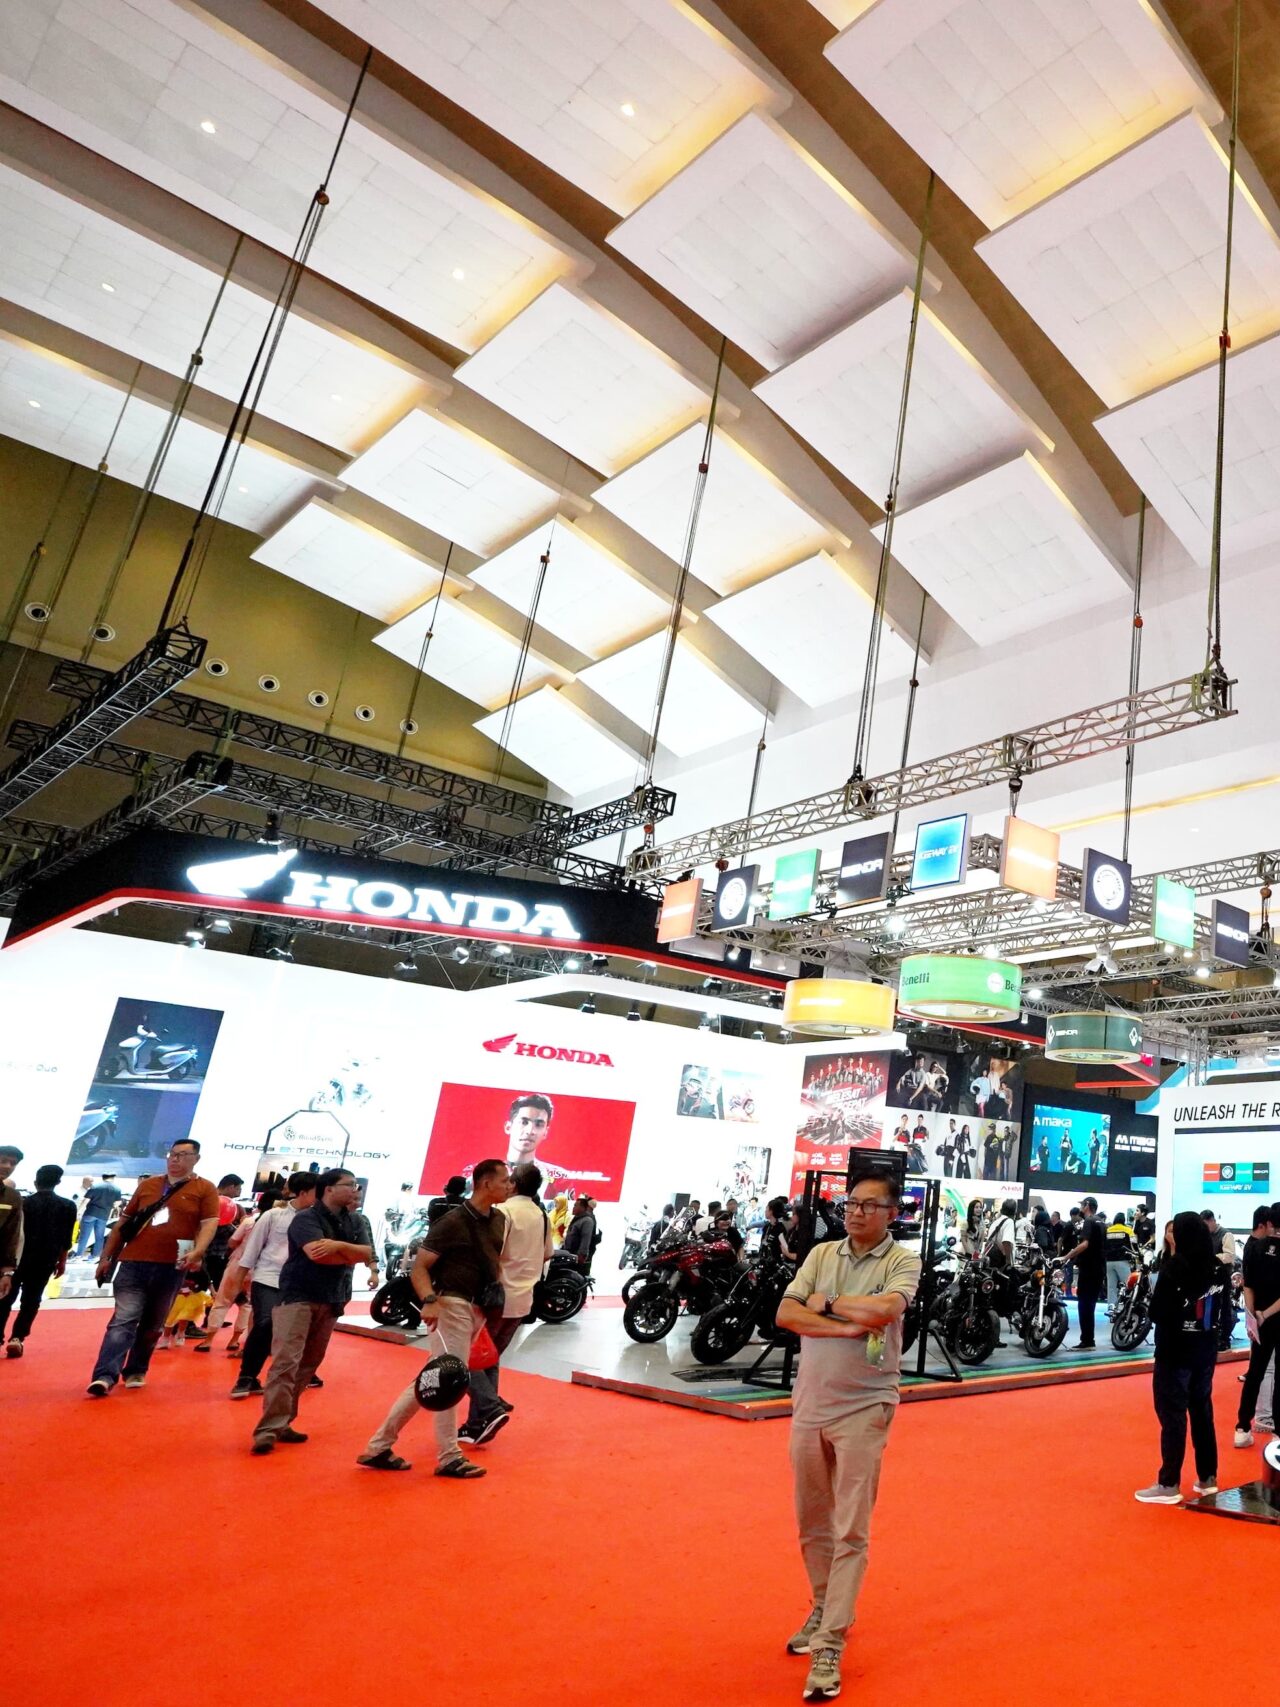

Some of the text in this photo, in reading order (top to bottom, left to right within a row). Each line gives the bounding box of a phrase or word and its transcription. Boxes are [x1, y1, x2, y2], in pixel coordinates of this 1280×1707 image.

[282, 870, 581, 940] HONDA
[513, 1042, 615, 1067] HONDA
[1173, 1103, 1237, 1122] UNLEASH
[1241, 1102, 1268, 1119] THE
